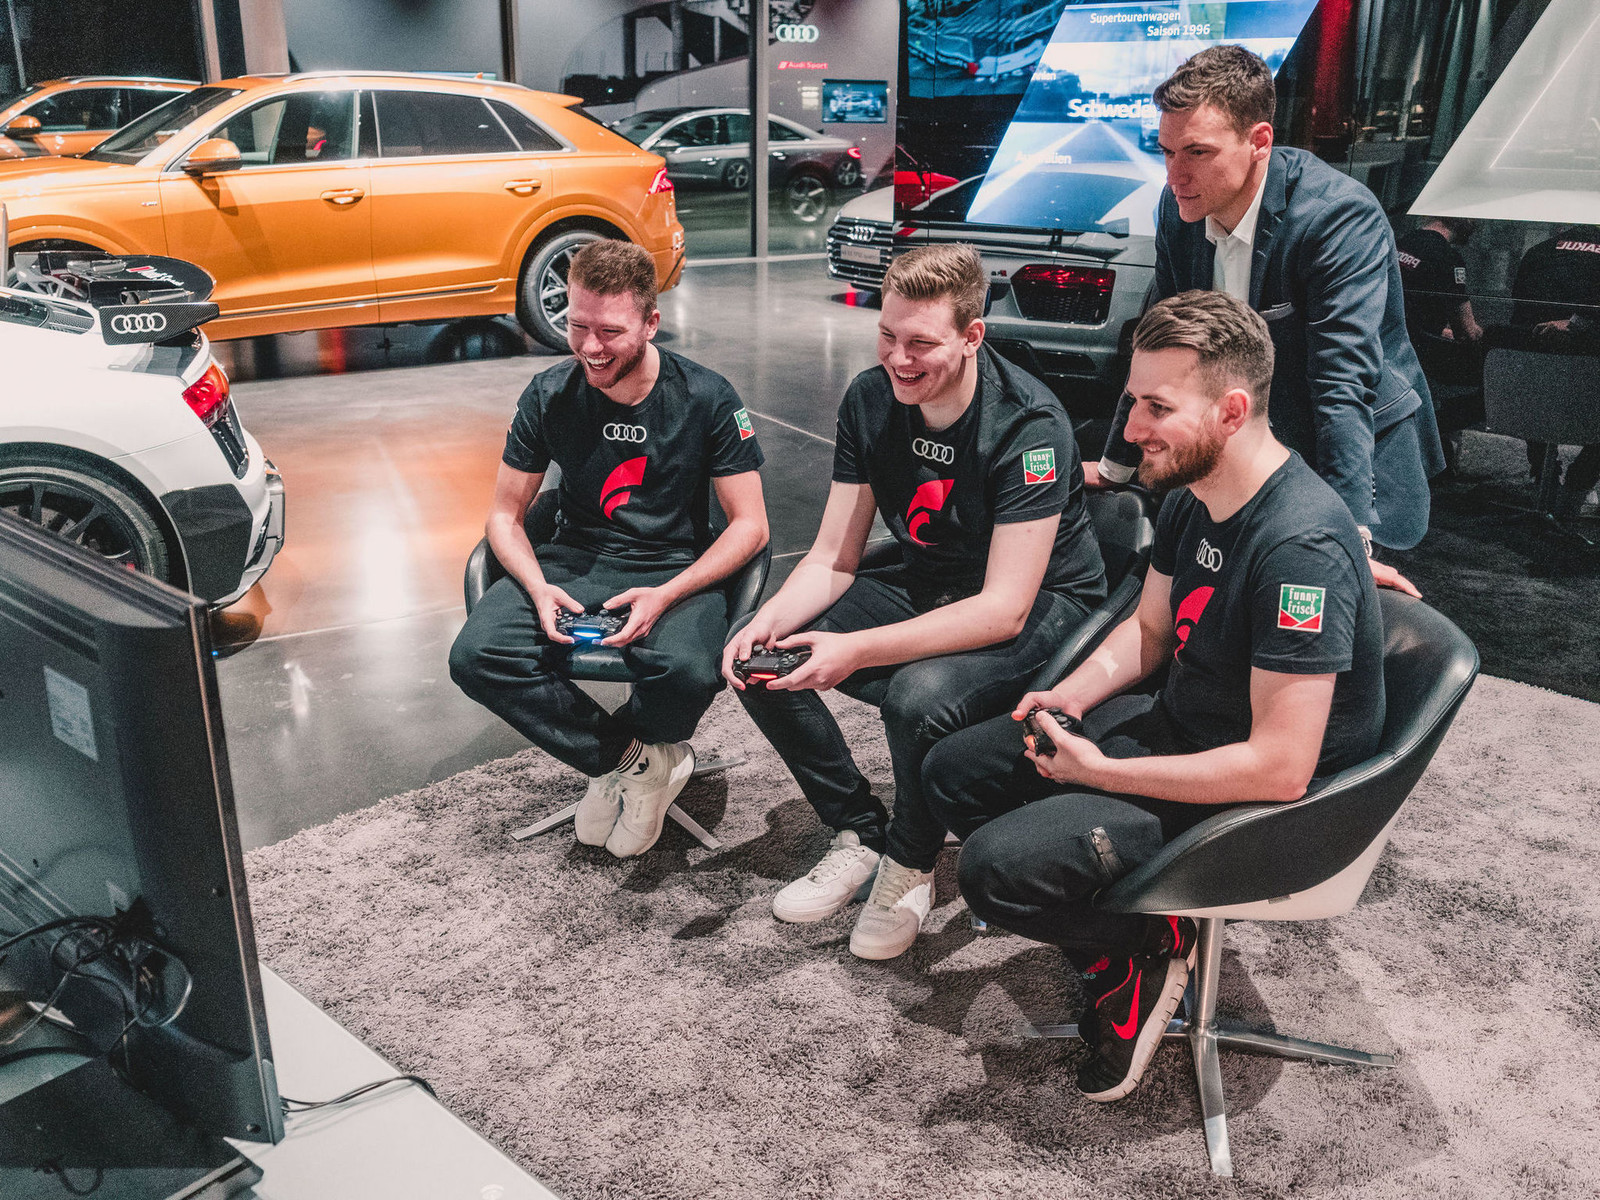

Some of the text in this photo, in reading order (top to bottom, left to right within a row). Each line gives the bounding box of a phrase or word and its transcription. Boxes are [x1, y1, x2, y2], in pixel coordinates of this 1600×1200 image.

[1090, 12, 1181, 25] Supertourenwagen
[1147, 23, 1211, 37] Saison 1996
[789, 61, 828, 69] Audi Sport
[1030, 461, 1050, 472] frisch
[1289, 587, 1319, 604] funny-
[1287, 600, 1315, 615] frisch
